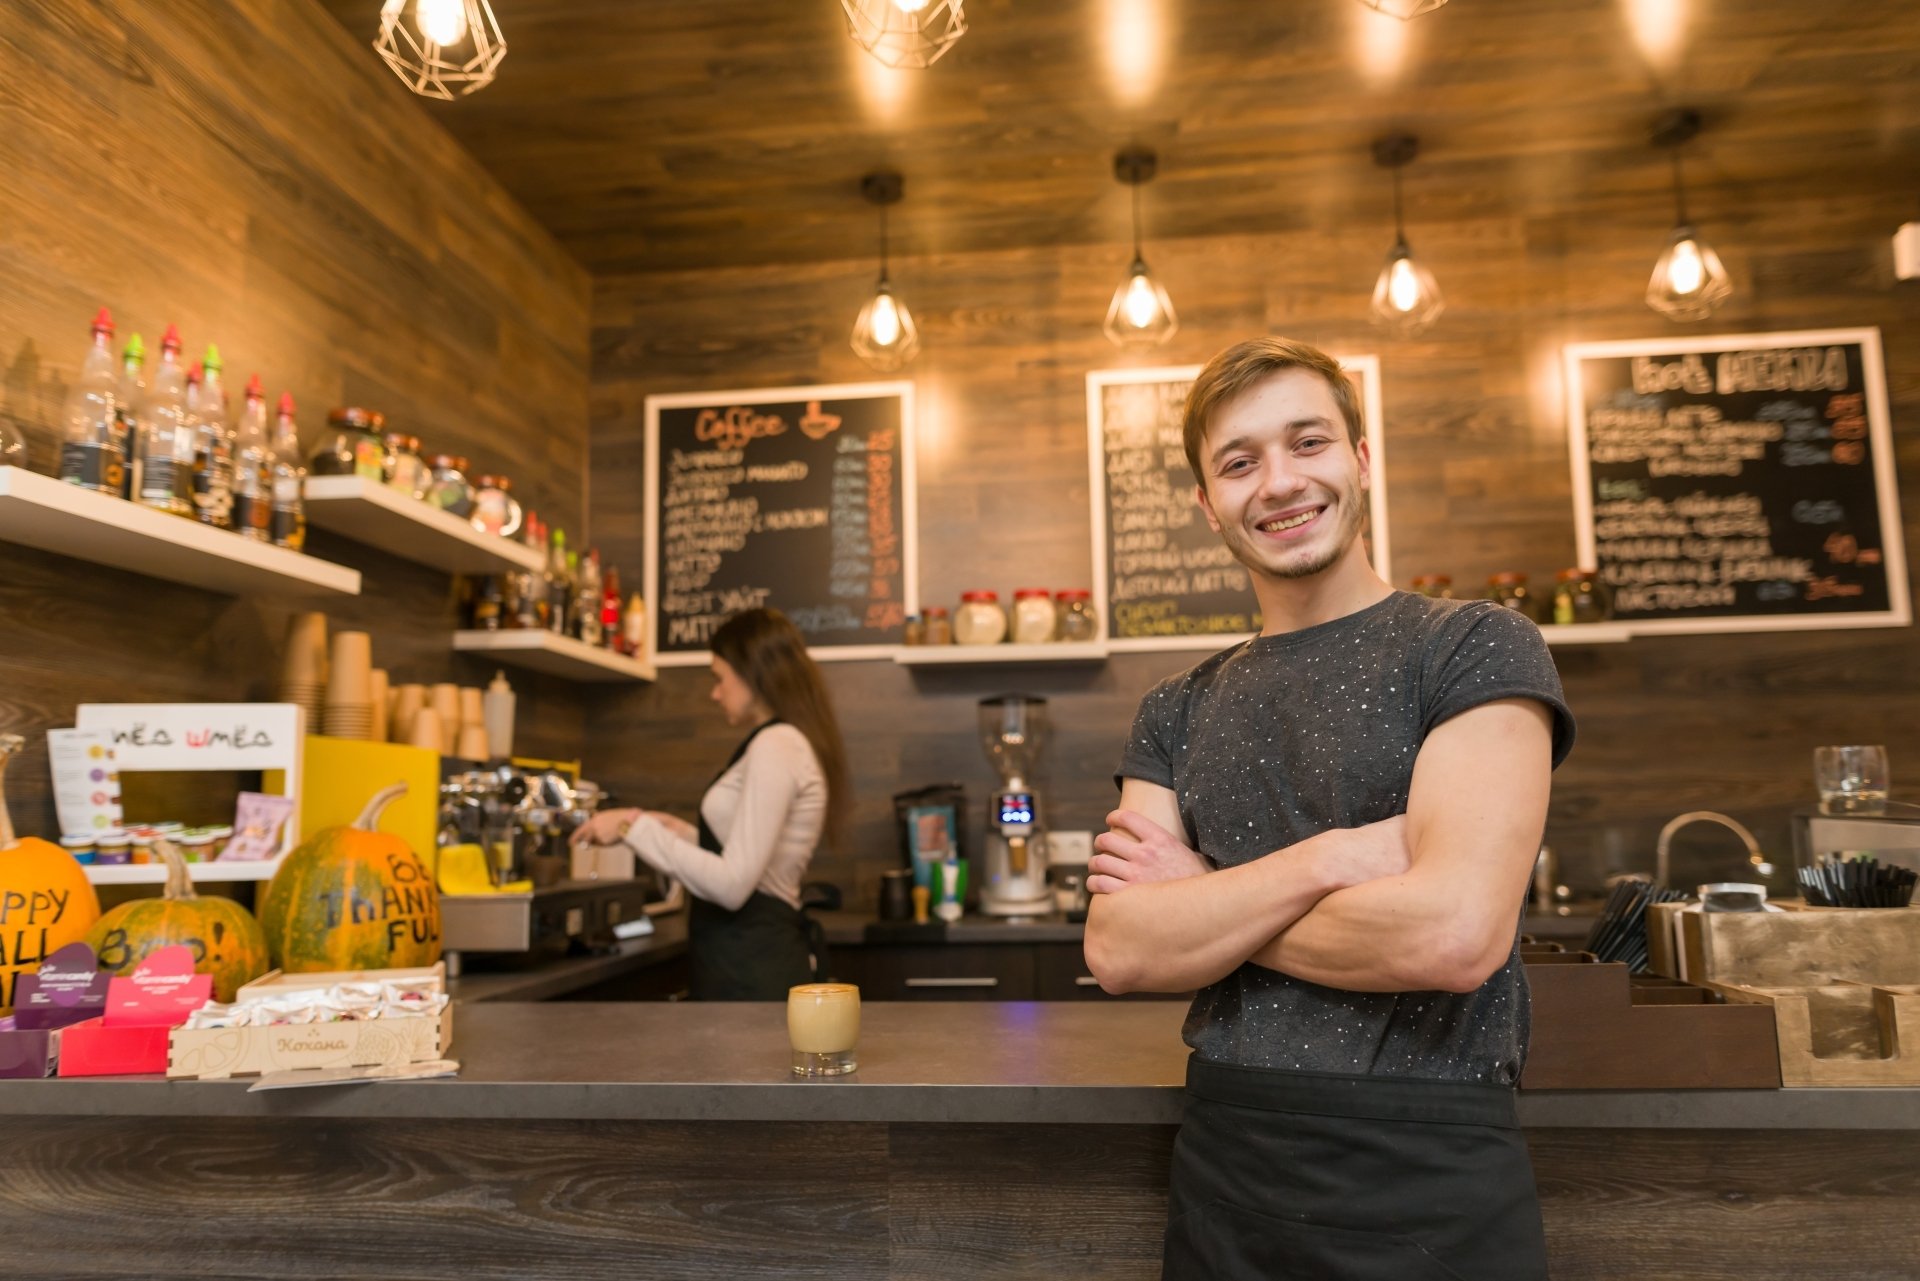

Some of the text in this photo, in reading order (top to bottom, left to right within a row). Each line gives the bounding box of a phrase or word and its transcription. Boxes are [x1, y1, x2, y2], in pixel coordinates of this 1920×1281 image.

[695, 406, 787, 449] Coffee
[0, 928, 52, 966] LL
[276, 1038, 349, 1053] Кохана
